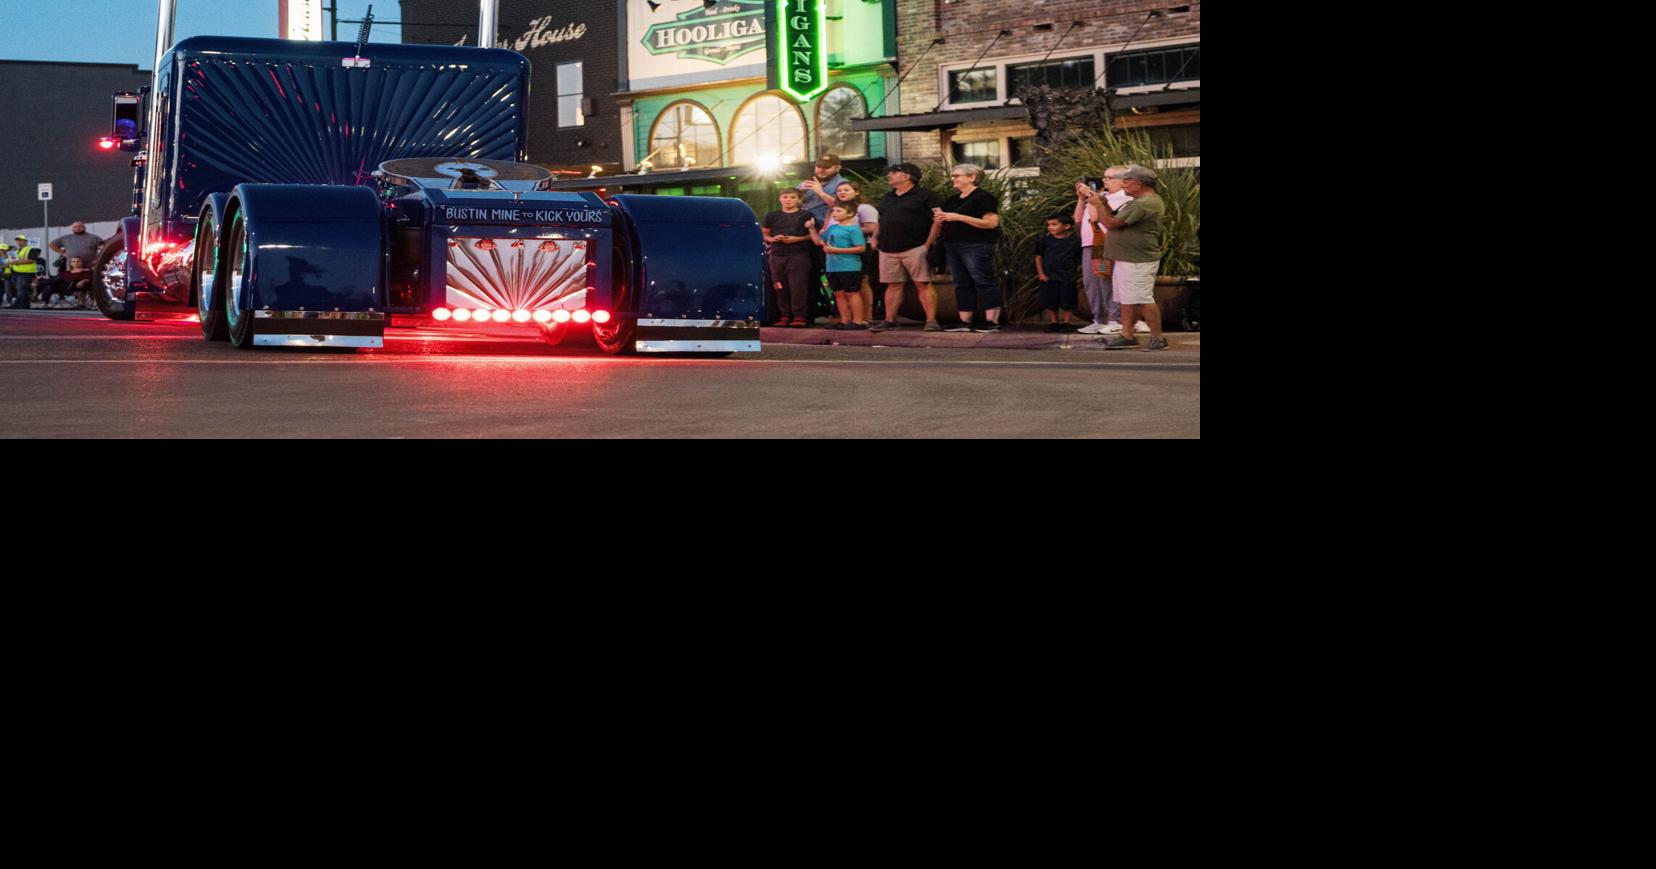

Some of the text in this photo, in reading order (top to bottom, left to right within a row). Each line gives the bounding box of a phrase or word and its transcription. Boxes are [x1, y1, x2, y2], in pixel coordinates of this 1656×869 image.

[514, 15, 588, 51] House
[656, 18, 766, 48] HOOLIGA
[491, 208, 521, 221] MINE
[535, 210, 564, 222] KICK
